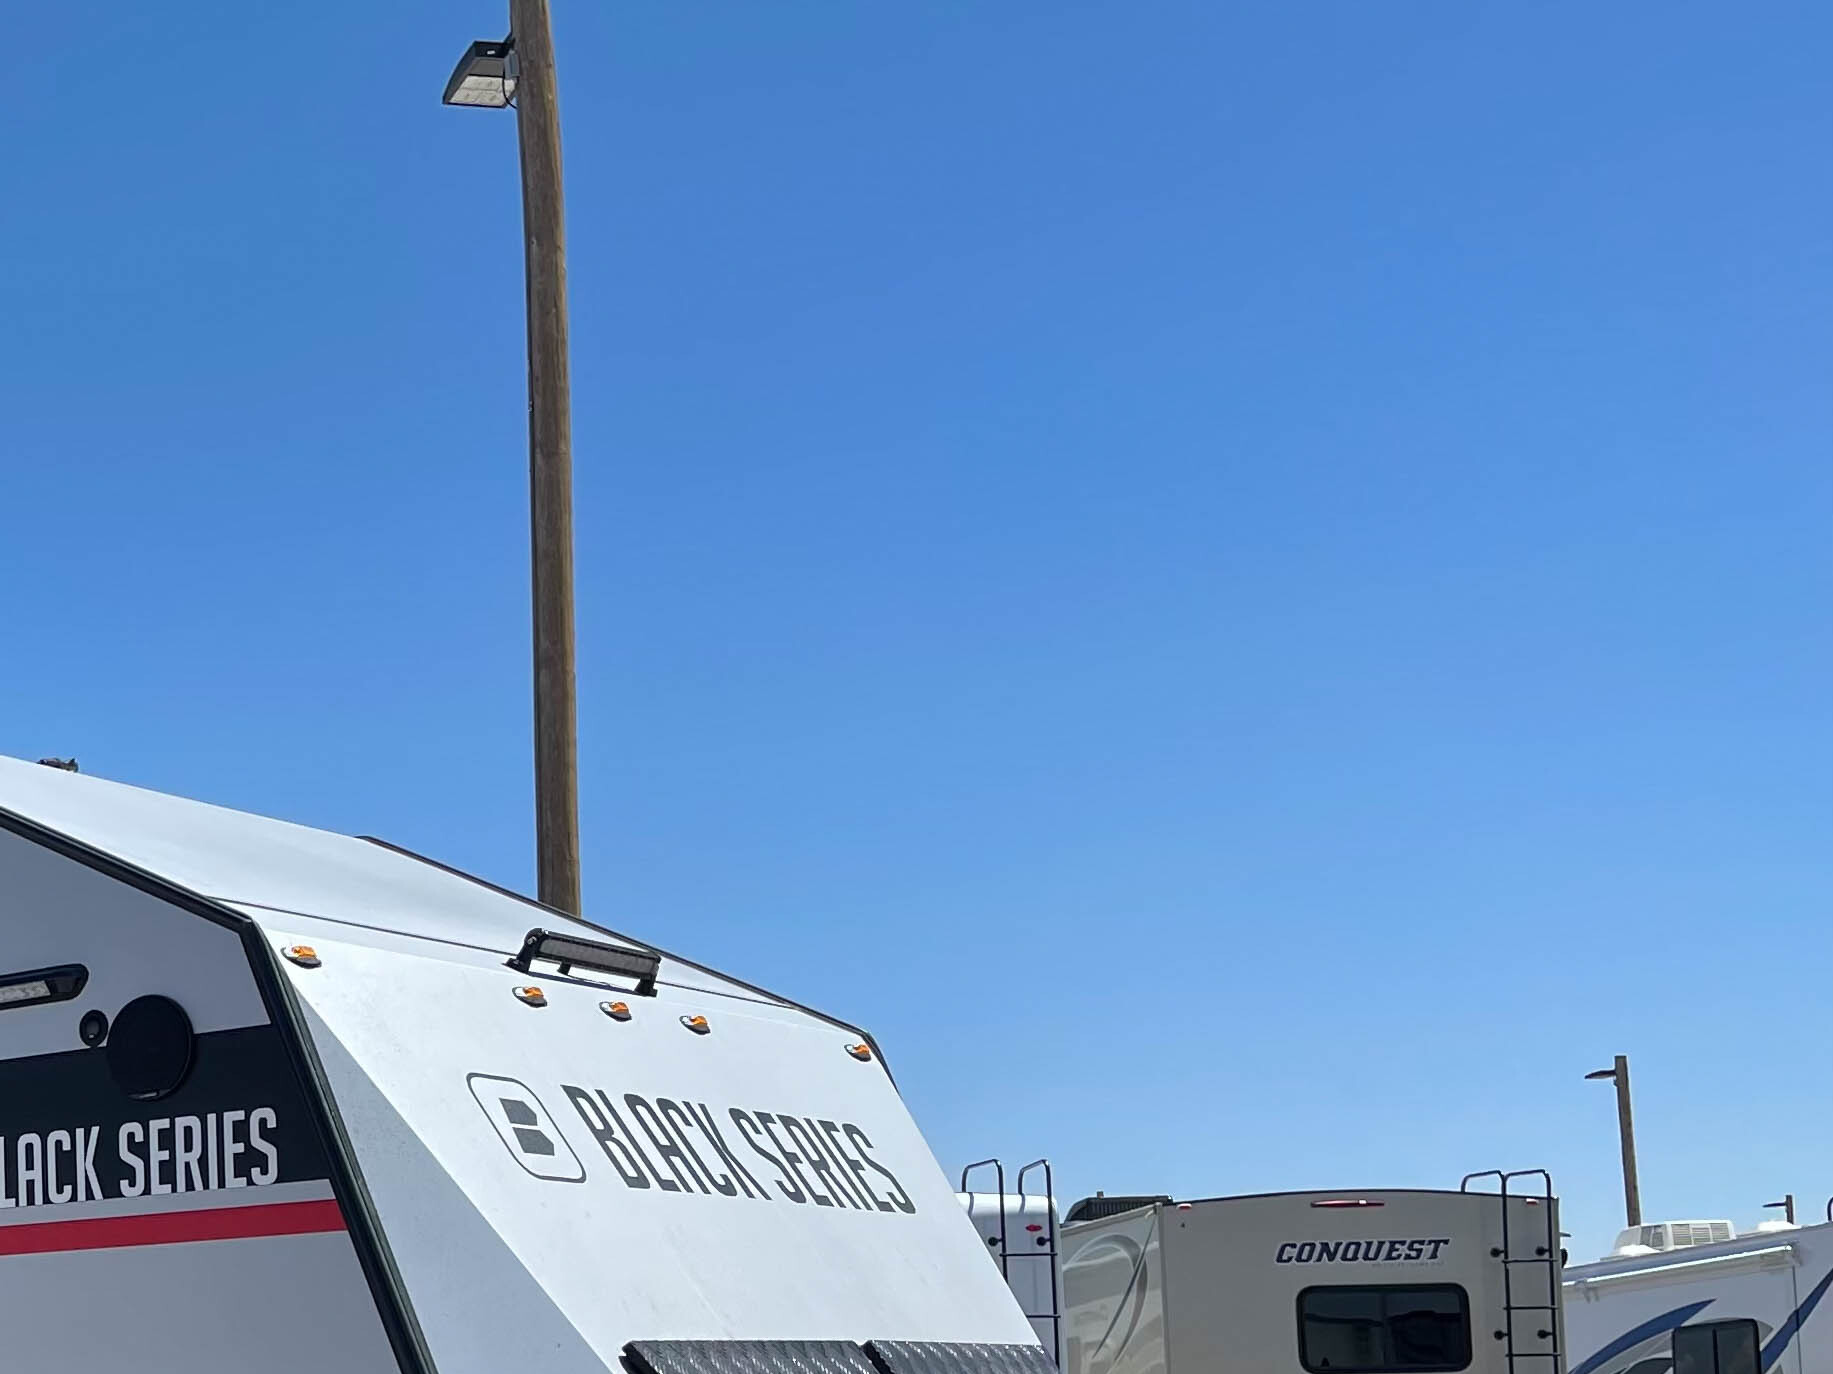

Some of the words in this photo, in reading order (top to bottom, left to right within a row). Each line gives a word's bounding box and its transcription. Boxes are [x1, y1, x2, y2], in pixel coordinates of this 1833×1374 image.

[118, 1107, 278, 1198] SERIES
[559, 1083, 773, 1201] BLACK
[727, 1106, 916, 1214] SERIES
[1275, 1238, 1451, 1264] CONQUEST
